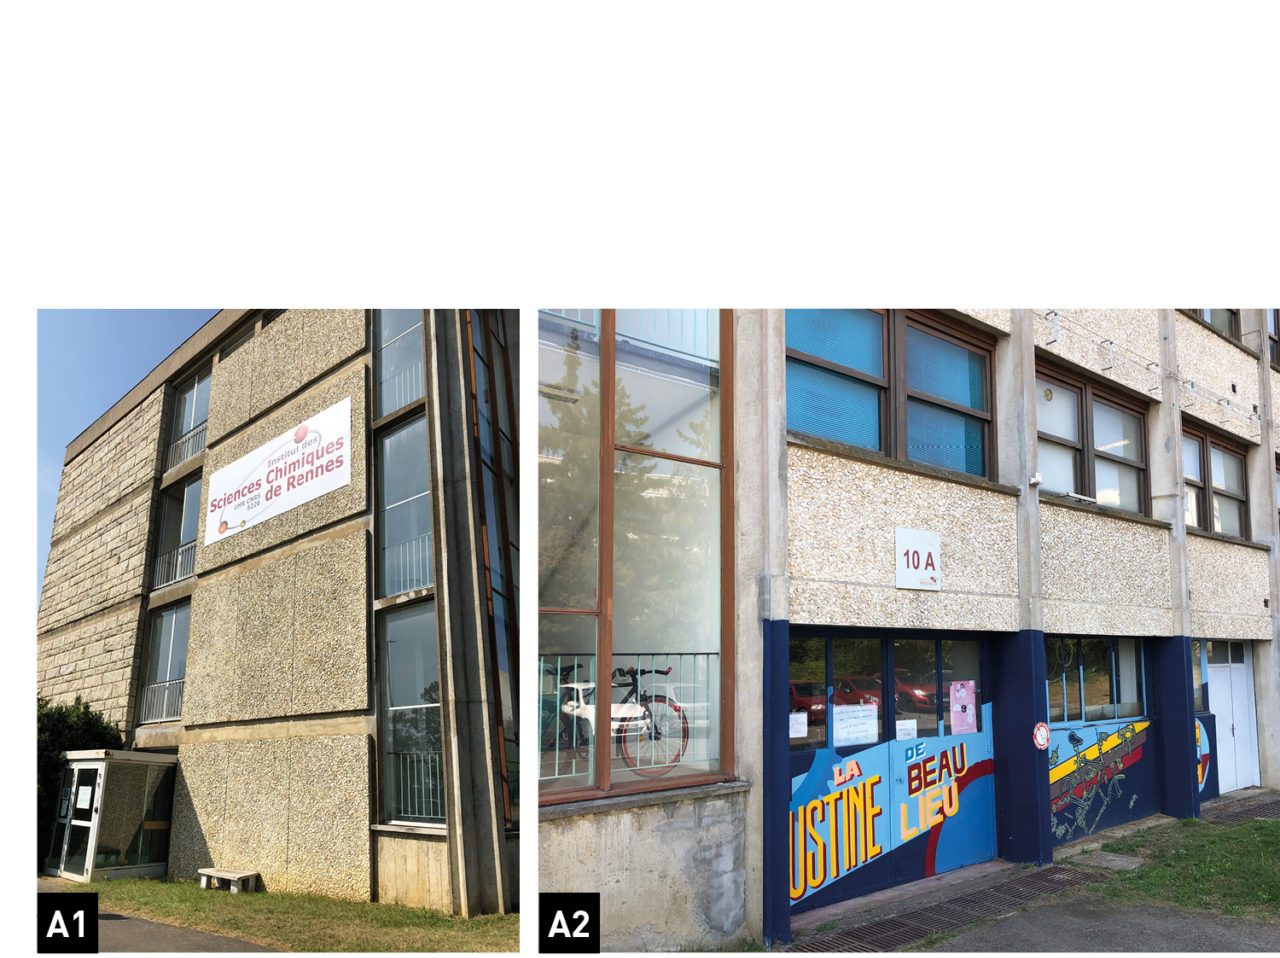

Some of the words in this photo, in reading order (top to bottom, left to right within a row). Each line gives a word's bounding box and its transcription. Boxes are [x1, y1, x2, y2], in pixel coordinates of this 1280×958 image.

[210, 479, 262, 513] Sciences
[266, 437, 345, 485] Chimiques
[268, 445, 299, 468] Institut
[302, 436, 319, 450] des
[265, 484, 282, 502] de
[286, 455, 345, 492] Rennes
[904, 549, 920, 570] 10
[924, 551, 936, 571] A
[833, 759, 862, 786] LA
[904, 741, 926, 764] DE
[907, 742, 967, 798] BEAU
[900, 780, 959, 842] LIEU
[789, 774, 882, 901] USTINE
